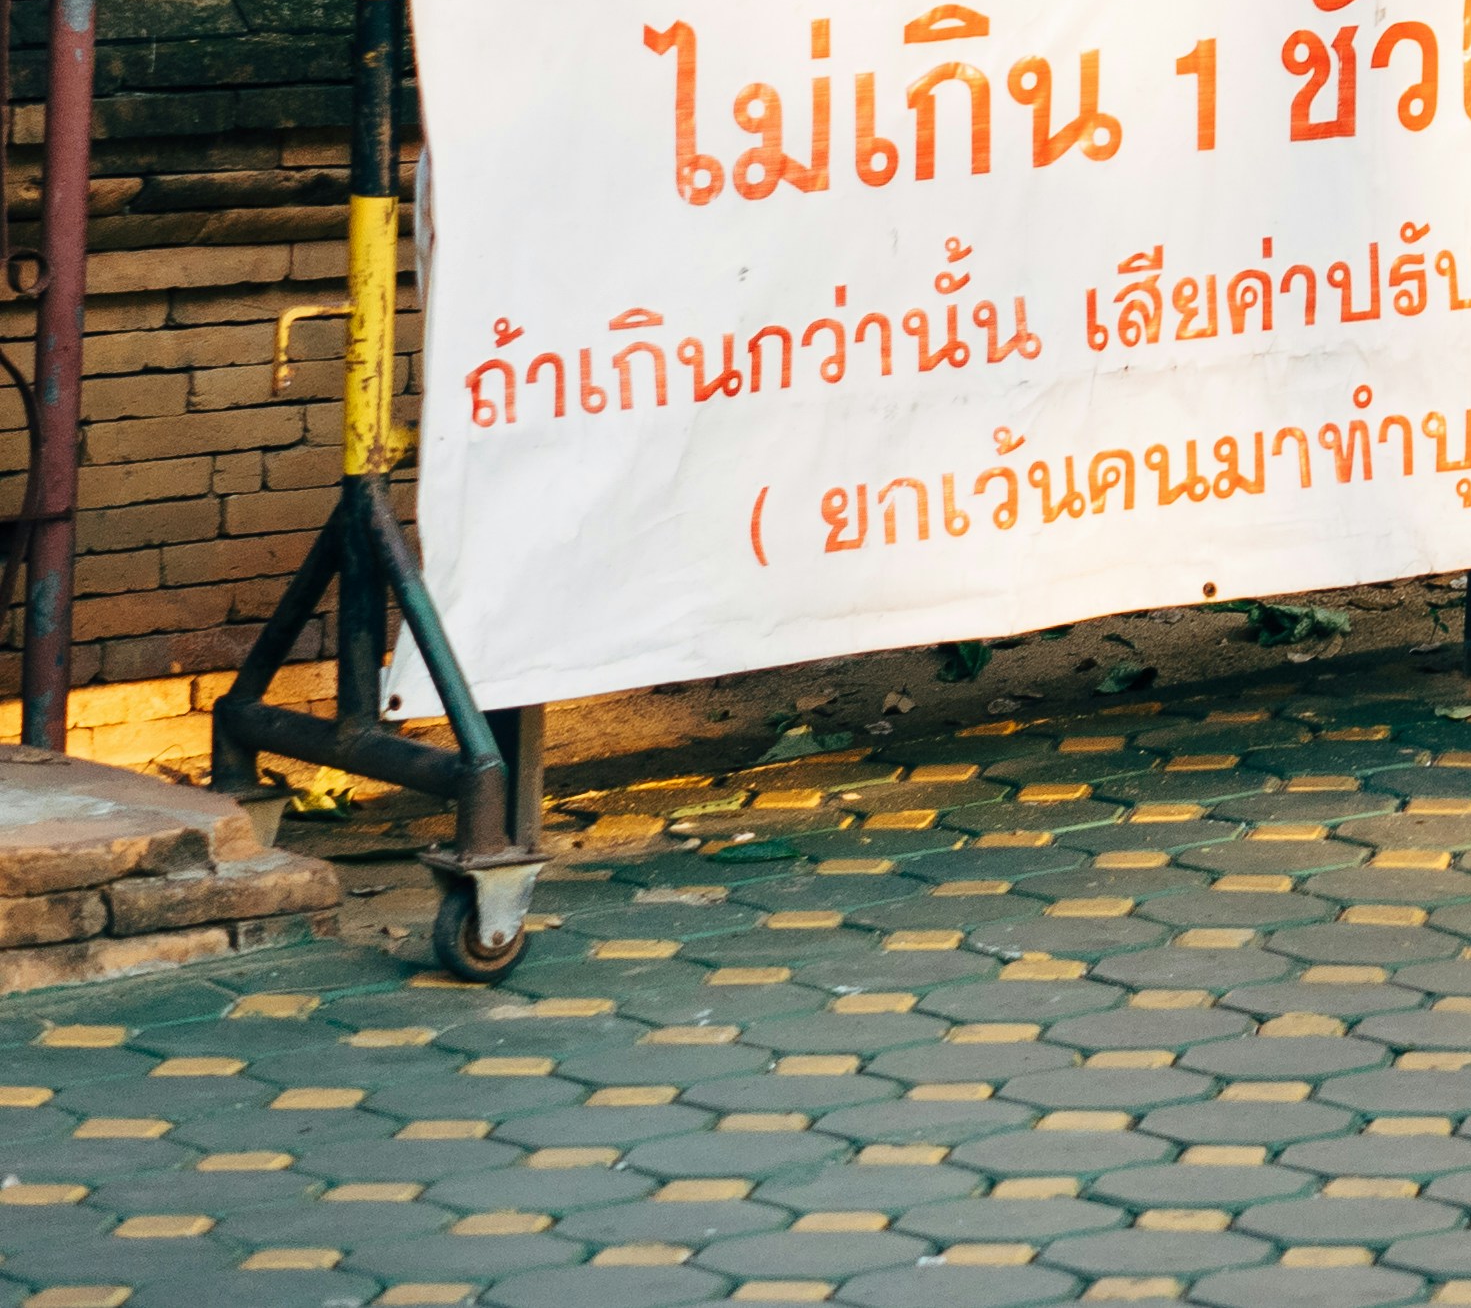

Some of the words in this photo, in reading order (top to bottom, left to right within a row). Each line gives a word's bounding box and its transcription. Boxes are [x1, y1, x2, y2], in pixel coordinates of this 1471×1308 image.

[641, 2, 1124, 207] ไม่เกิน
[1174, 37, 1218, 152] 1
[464, 235, 1044, 429] ถ้าเกินกว่านั้น
